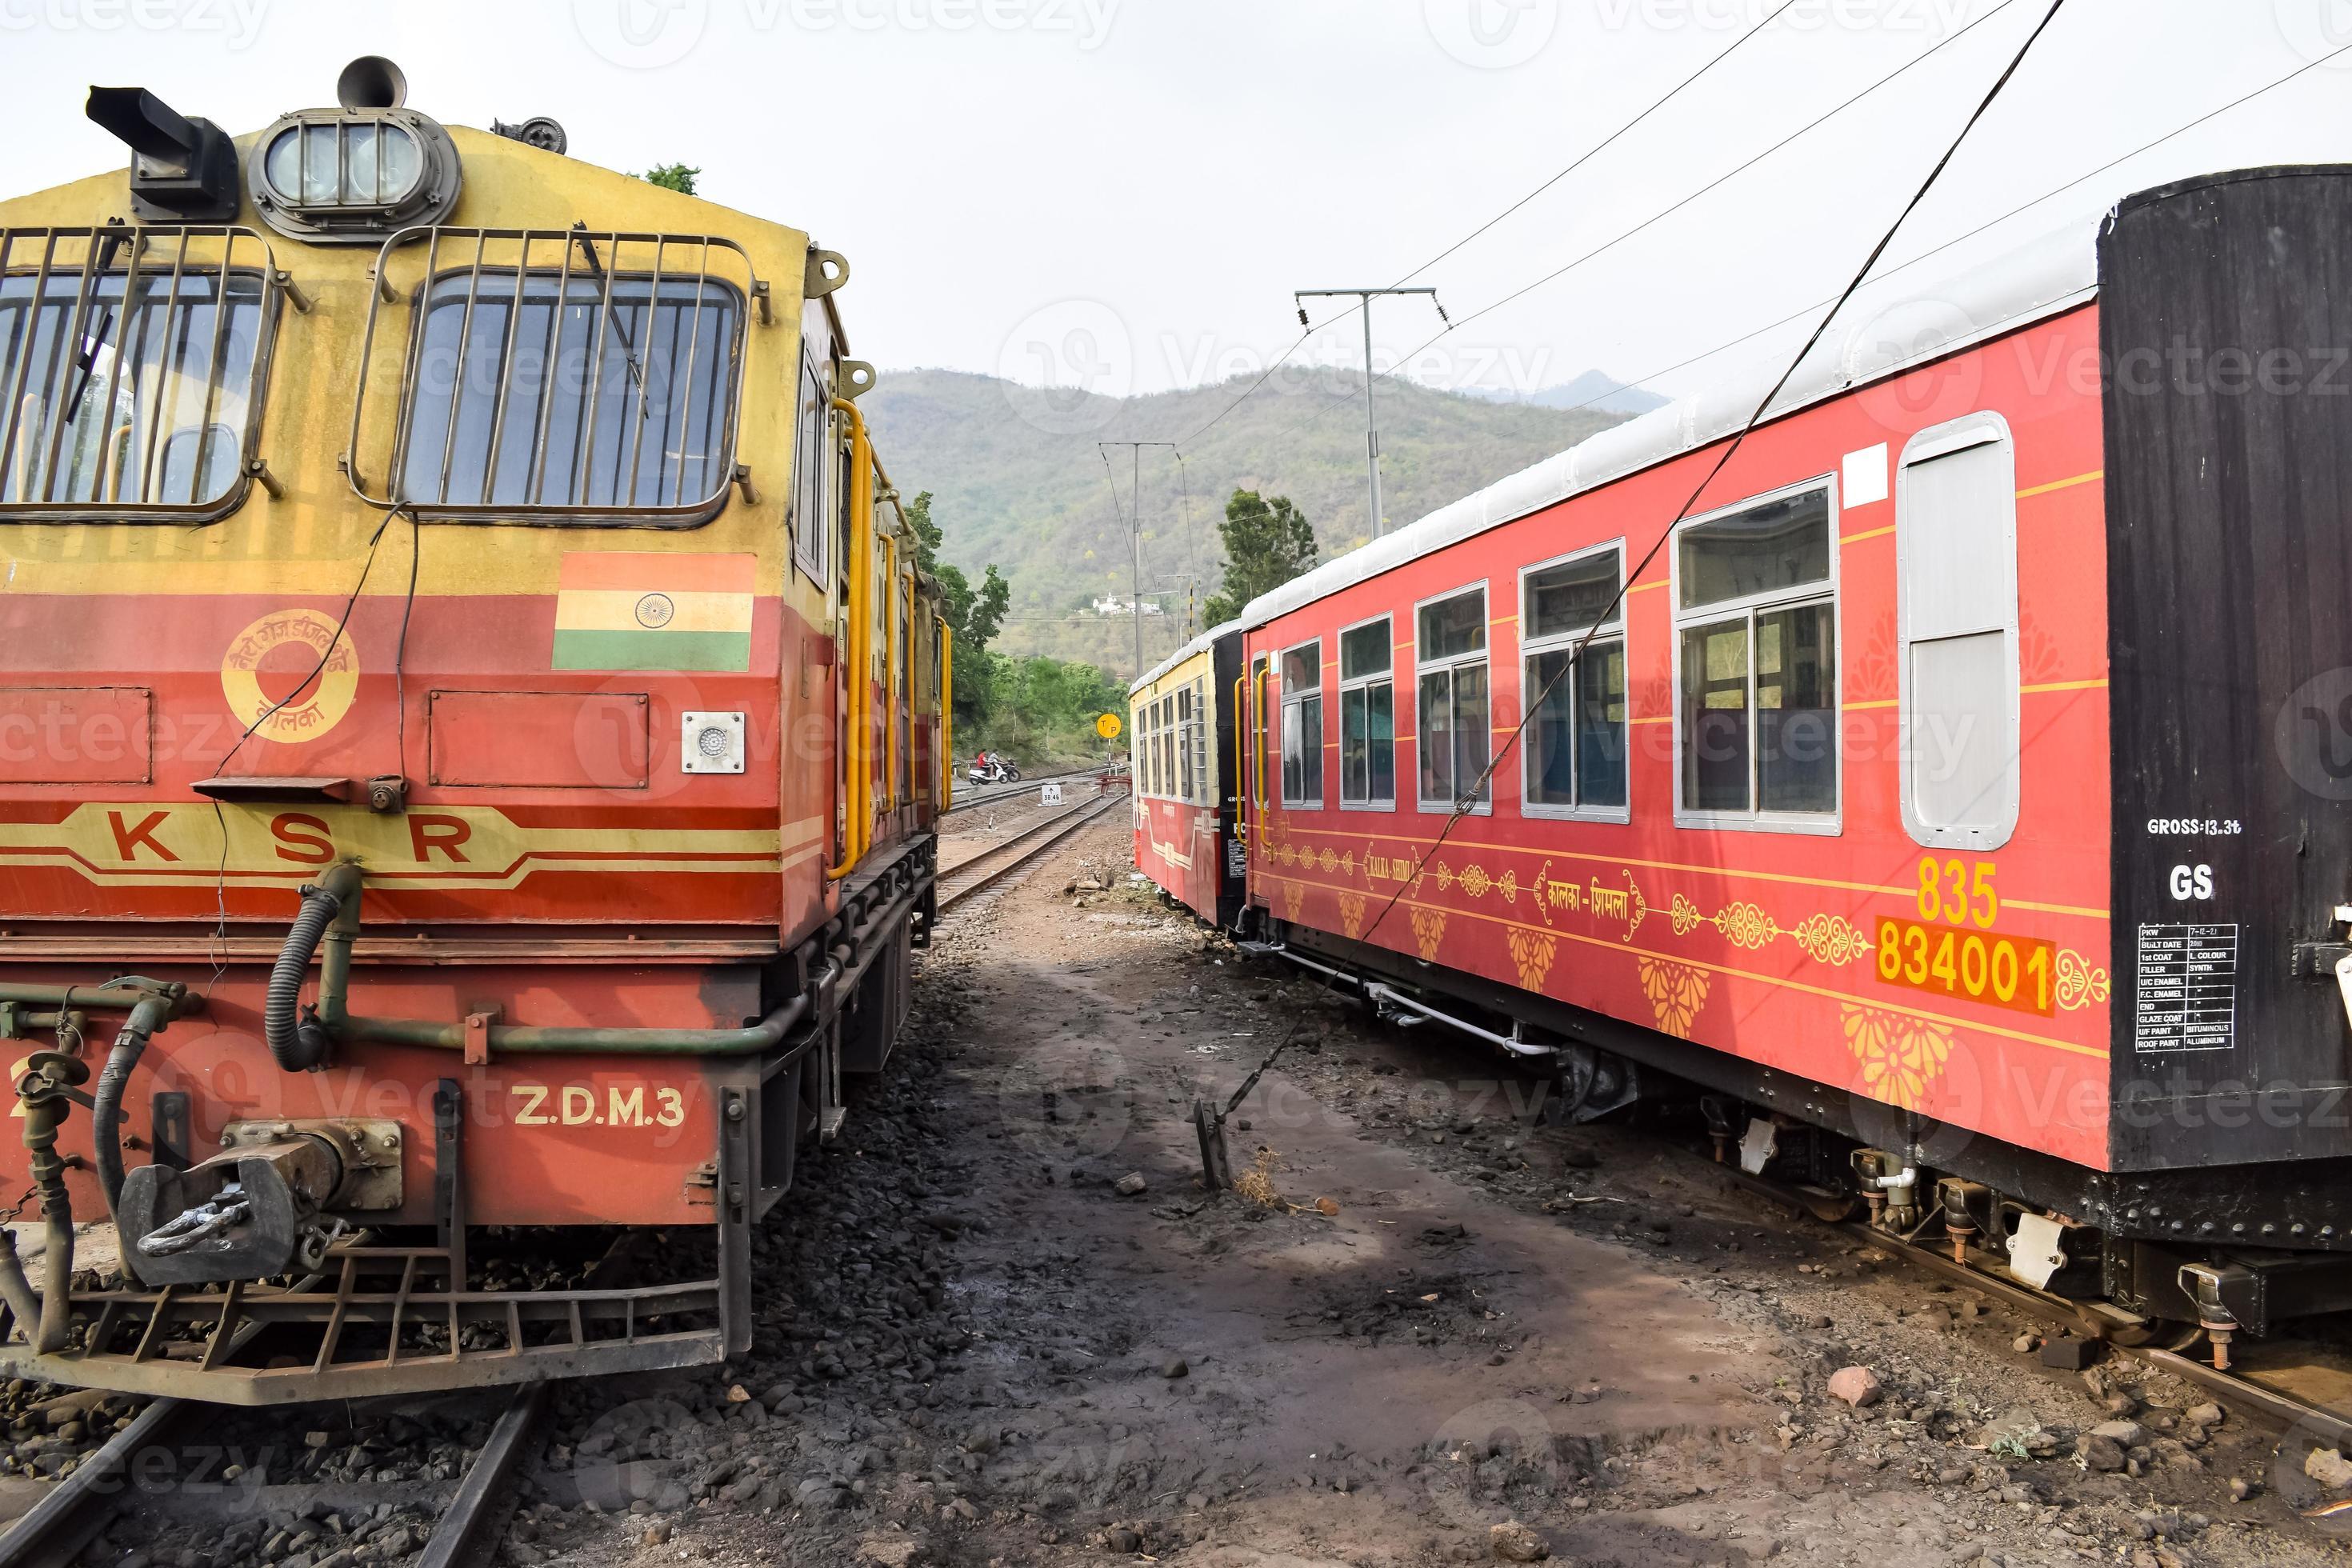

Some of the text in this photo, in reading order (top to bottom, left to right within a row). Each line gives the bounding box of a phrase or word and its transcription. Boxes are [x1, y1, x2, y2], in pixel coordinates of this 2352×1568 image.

[108, 810, 472, 864] K S R
[1370, 856, 1390, 879] KALKA
[2170, 863, 2213, 901] GS
[1918, 856, 1998, 929] 835
[1547, 880, 1581, 912] कालका
[1590, 876, 1629, 921] शिमला
[2141, 929, 2159, 937] PKW
[2162, 941, 2182, 949] DATE
[2153, 953, 2173, 961] COAT
[2197, 951, 2226, 959] COLOUR
[1878, 921, 2048, 1010] 834001
[2141, 966, 2166, 974] FILLER
[2154, 978, 2182, 986] ENAMEL
[2154, 990, 2182, 998] ENAMEL
[2139, 1014, 2182, 1023] GLAZE COAT
[2152, 1027, 2172, 1035] PAINT
[2186, 1024, 2229, 1033] BITUMINOUS
[2138, 1039, 2180, 1048] ROOF PAINT
[2186, 1037, 2225, 1045] ALUMINIUM
[511, 1085, 685, 1127] Z.D.M.3
